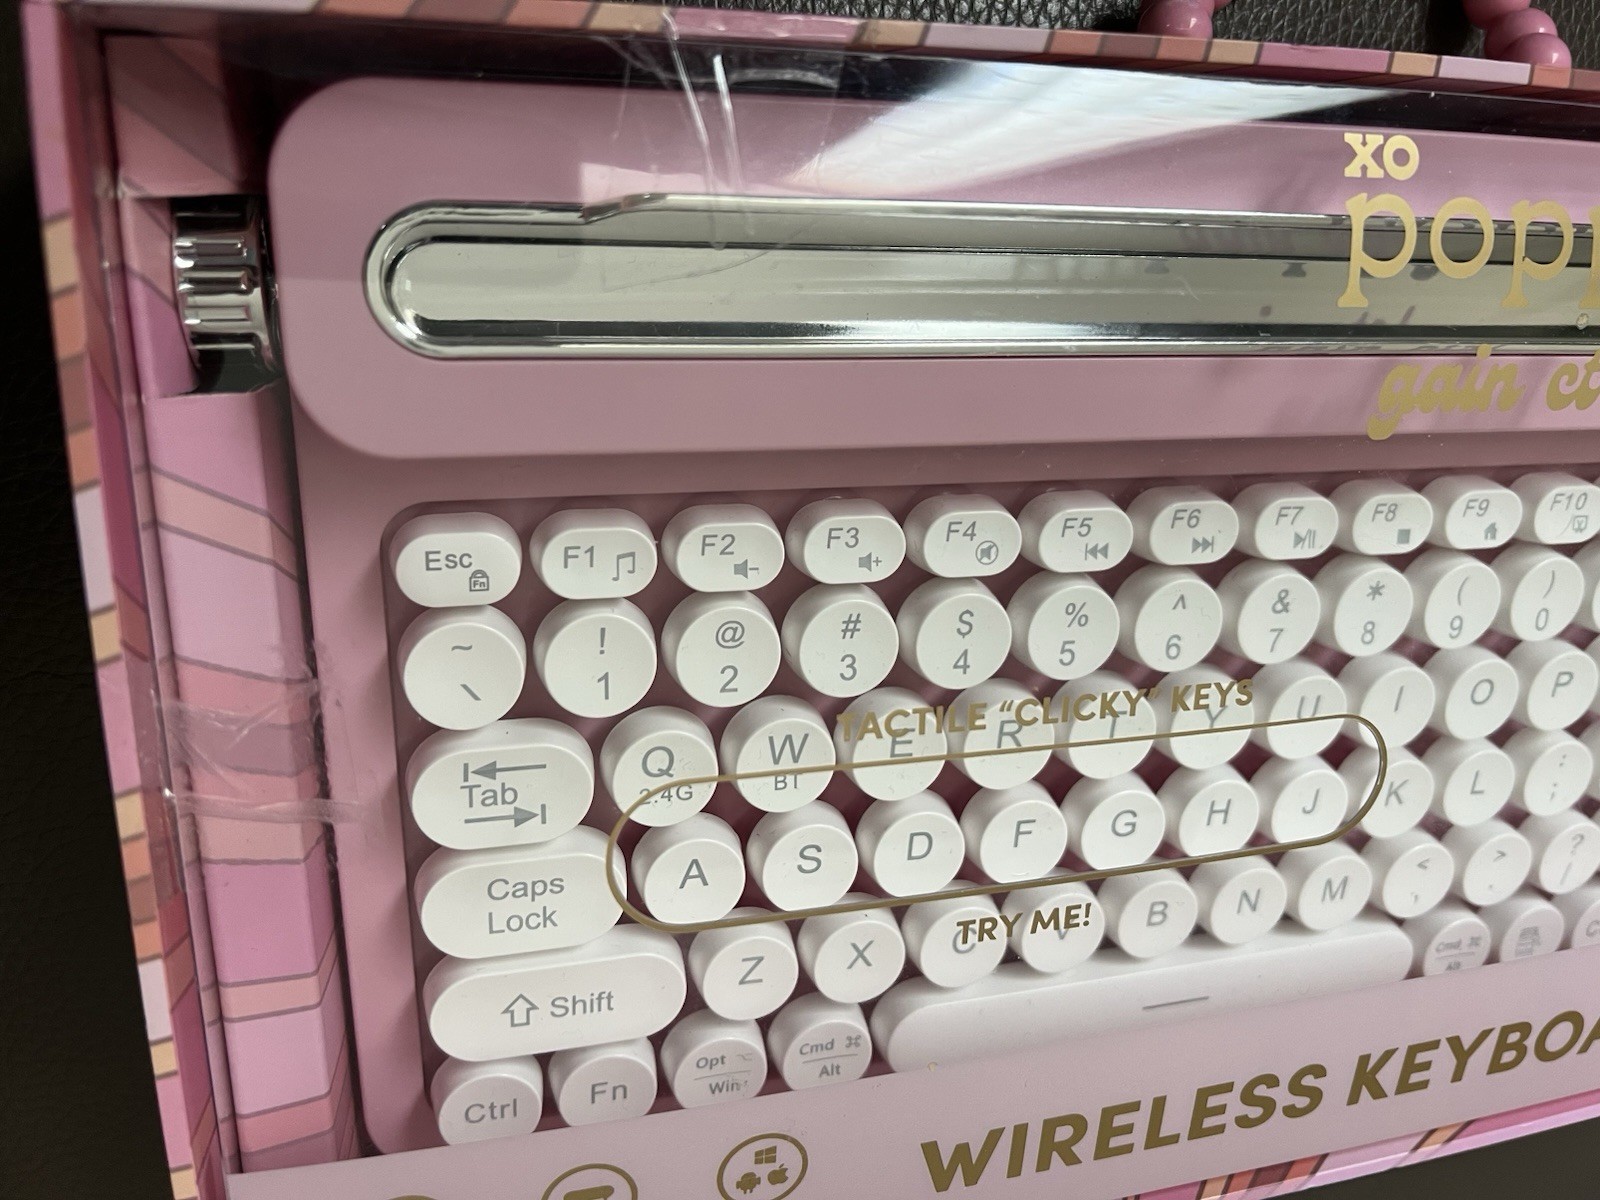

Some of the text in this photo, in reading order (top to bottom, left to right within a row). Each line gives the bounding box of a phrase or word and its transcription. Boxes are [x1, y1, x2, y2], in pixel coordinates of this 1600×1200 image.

[1366, 343, 1526, 440] gain
[1371, 502, 1399, 523] F8
[1462, 498, 1491, 518] F9
[1549, 491, 1589, 512] F10
[1060, 516, 1093, 538] F5
[1170, 508, 1202, 529] F6
[1274, 505, 1305, 527] F7
[700, 533, 736, 557] F2
[826, 526, 860, 549] F3
[944, 520, 977, 543] F4
[424, 550, 473, 571] Esc
[562, 545, 596, 569] F1
[1064, 601, 1089, 628] %
[1270, 588, 1290, 615] &
[840, 612, 862, 640] #
[955, 608, 975, 639] $
[1360, 619, 1376, 645] 8
[1448, 614, 1464, 640] 9
[1534, 607, 1549, 632] 0
[714, 619, 746, 649] @
[1164, 633, 1182, 661] 6
[1268, 627, 1284, 653] 7
[952, 648, 971, 675] 4
[1058, 639, 1076, 667] 5
[719, 664, 739, 694] 2
[839, 653, 858, 682] 3
[596, 671, 610, 700] 1
[1470, 677, 1495, 706] O
[1551, 670, 1574, 698] P
[836, 702, 988, 742] TACTILE
[1170, 678, 1254, 714] KEYS
[889, 727, 916, 758] E
[996, 719, 1023, 749] R
[641, 745, 675, 778] Q
[767, 732, 810, 766] W
[460, 782, 519, 808] Tab
[1384, 778, 1410, 808] K
[1469, 769, 1485, 795] L
[1205, 798, 1233, 827] H
[1301, 787, 1321, 815] J
[1012, 818, 1037, 849] F
[1110, 808, 1138, 838] G
[796, 843, 823, 874] S
[906, 830, 934, 862] D
[678, 857, 710, 890] A
[487, 876, 566, 905] Caps
[1236, 887, 1261, 915] N
[1320, 875, 1350, 903] M
[487, 905, 559, 935] Lock
[956, 911, 1024, 945] TRY
[1029, 902, 1092, 935] ME!
[1145, 901, 1169, 928] B
[845, 939, 875, 970] X
[738, 956, 765, 986] Z
[549, 990, 615, 1019] Shift
[799, 1037, 836, 1056] Cmd
[695, 1054, 727, 1072] Opt
[818, 1063, 841, 1079] Alt
[589, 1081, 628, 1105] Fn
[708, 1078, 740, 1095] Win
[463, 1097, 518, 1125] Ctrl
[920, 1062, 1329, 1193] WIRELESS
